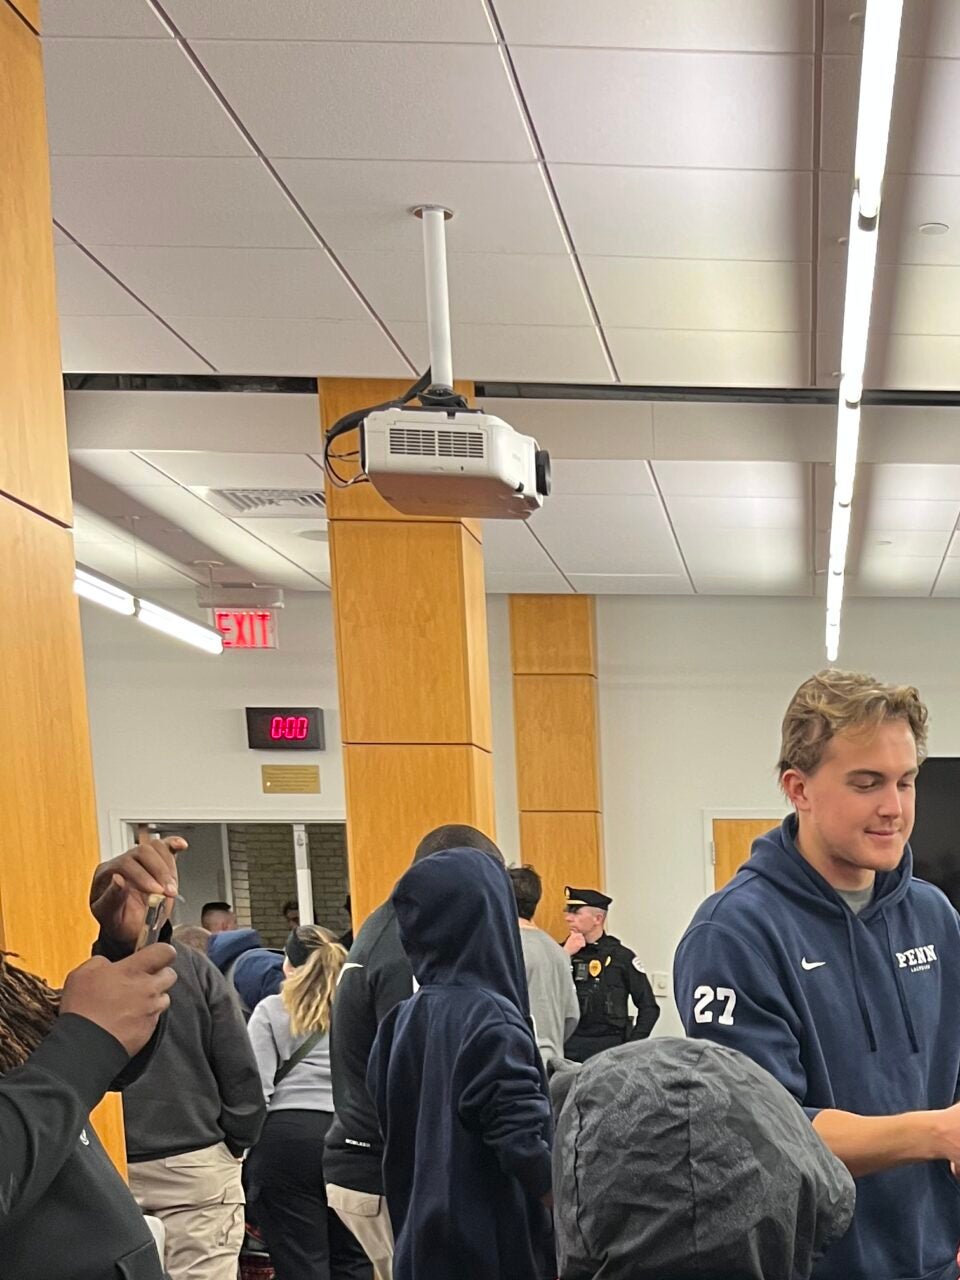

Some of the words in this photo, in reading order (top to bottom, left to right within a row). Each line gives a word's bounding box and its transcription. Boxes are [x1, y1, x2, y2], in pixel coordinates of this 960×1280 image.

[215, 612, 271, 648] EXIT
[895, 944, 938, 968] PENN
[693, 985, 737, 1026] 27
